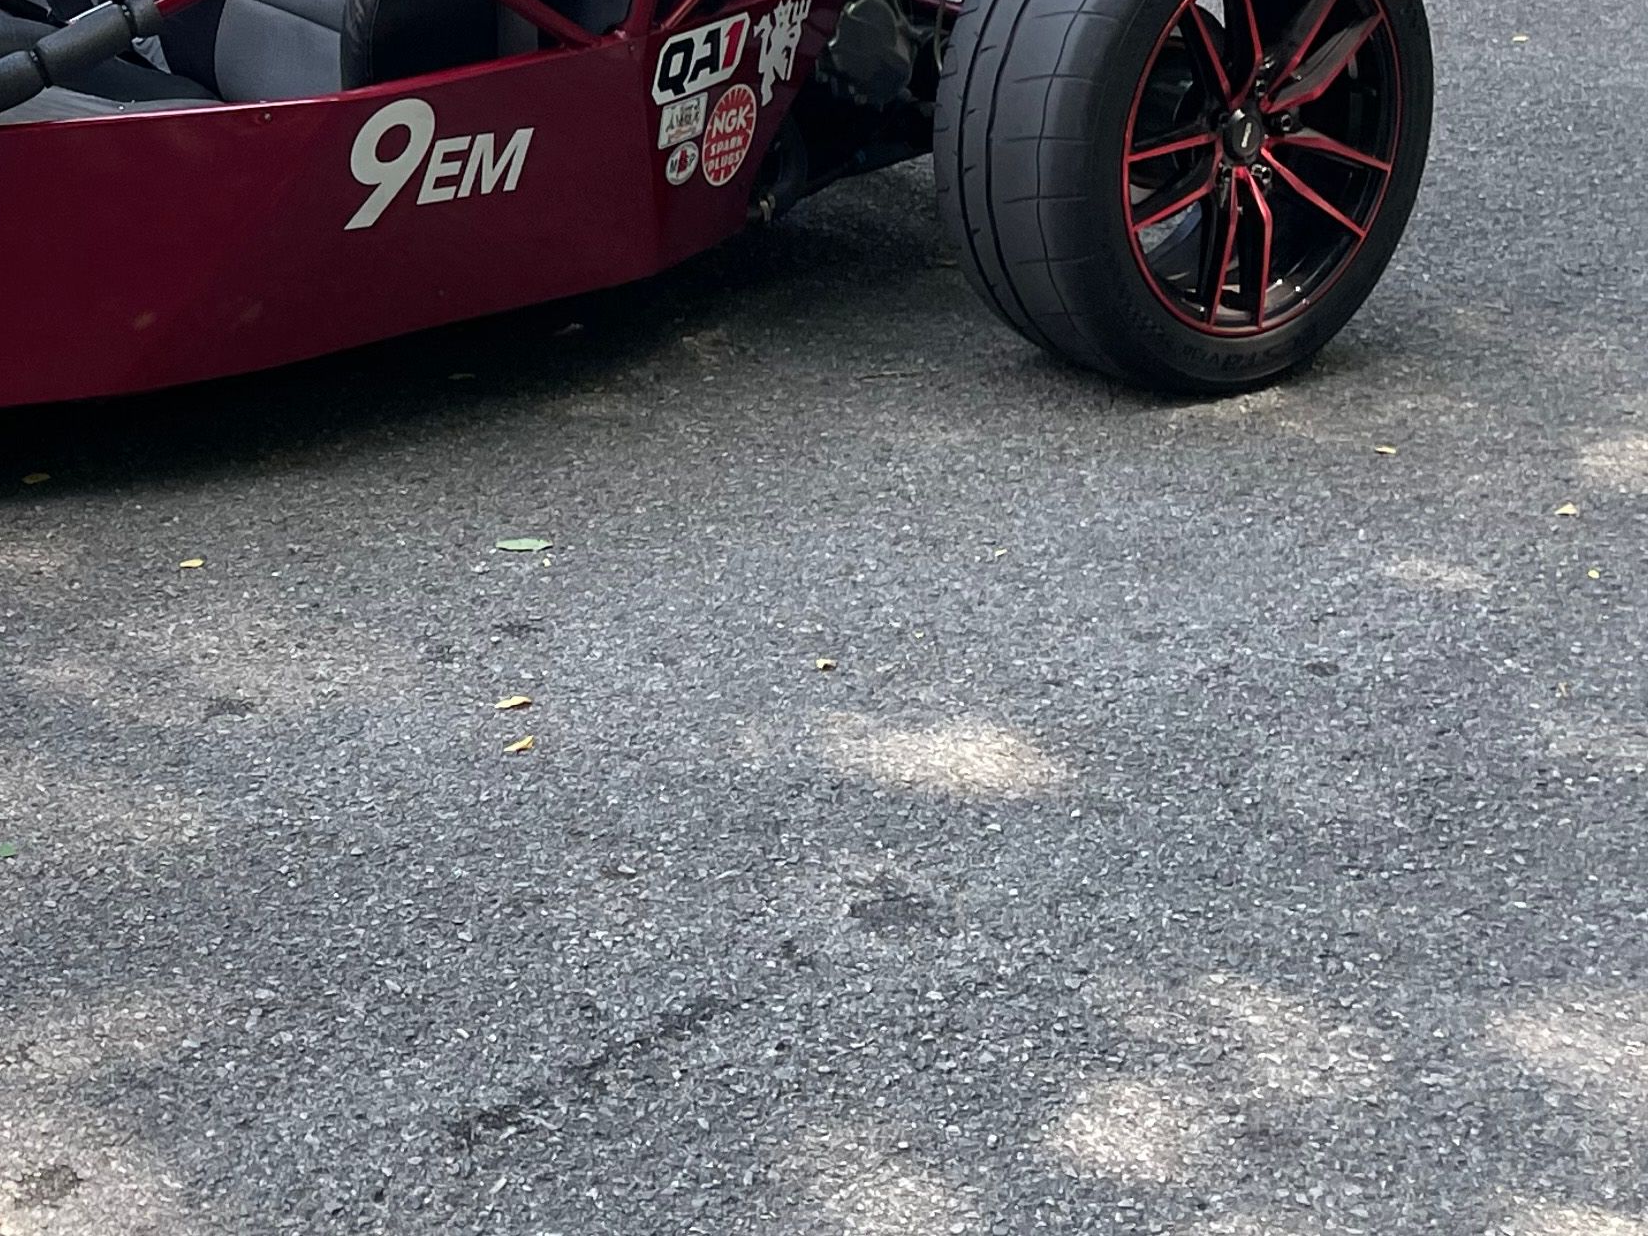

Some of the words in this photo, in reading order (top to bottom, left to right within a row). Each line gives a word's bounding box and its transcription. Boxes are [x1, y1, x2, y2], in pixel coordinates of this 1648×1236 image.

[657, 19, 746, 96] QA1
[710, 104, 751, 139] NGK
[710, 135, 745, 157] SPARK
[706, 150, 743, 172] PLUGS
